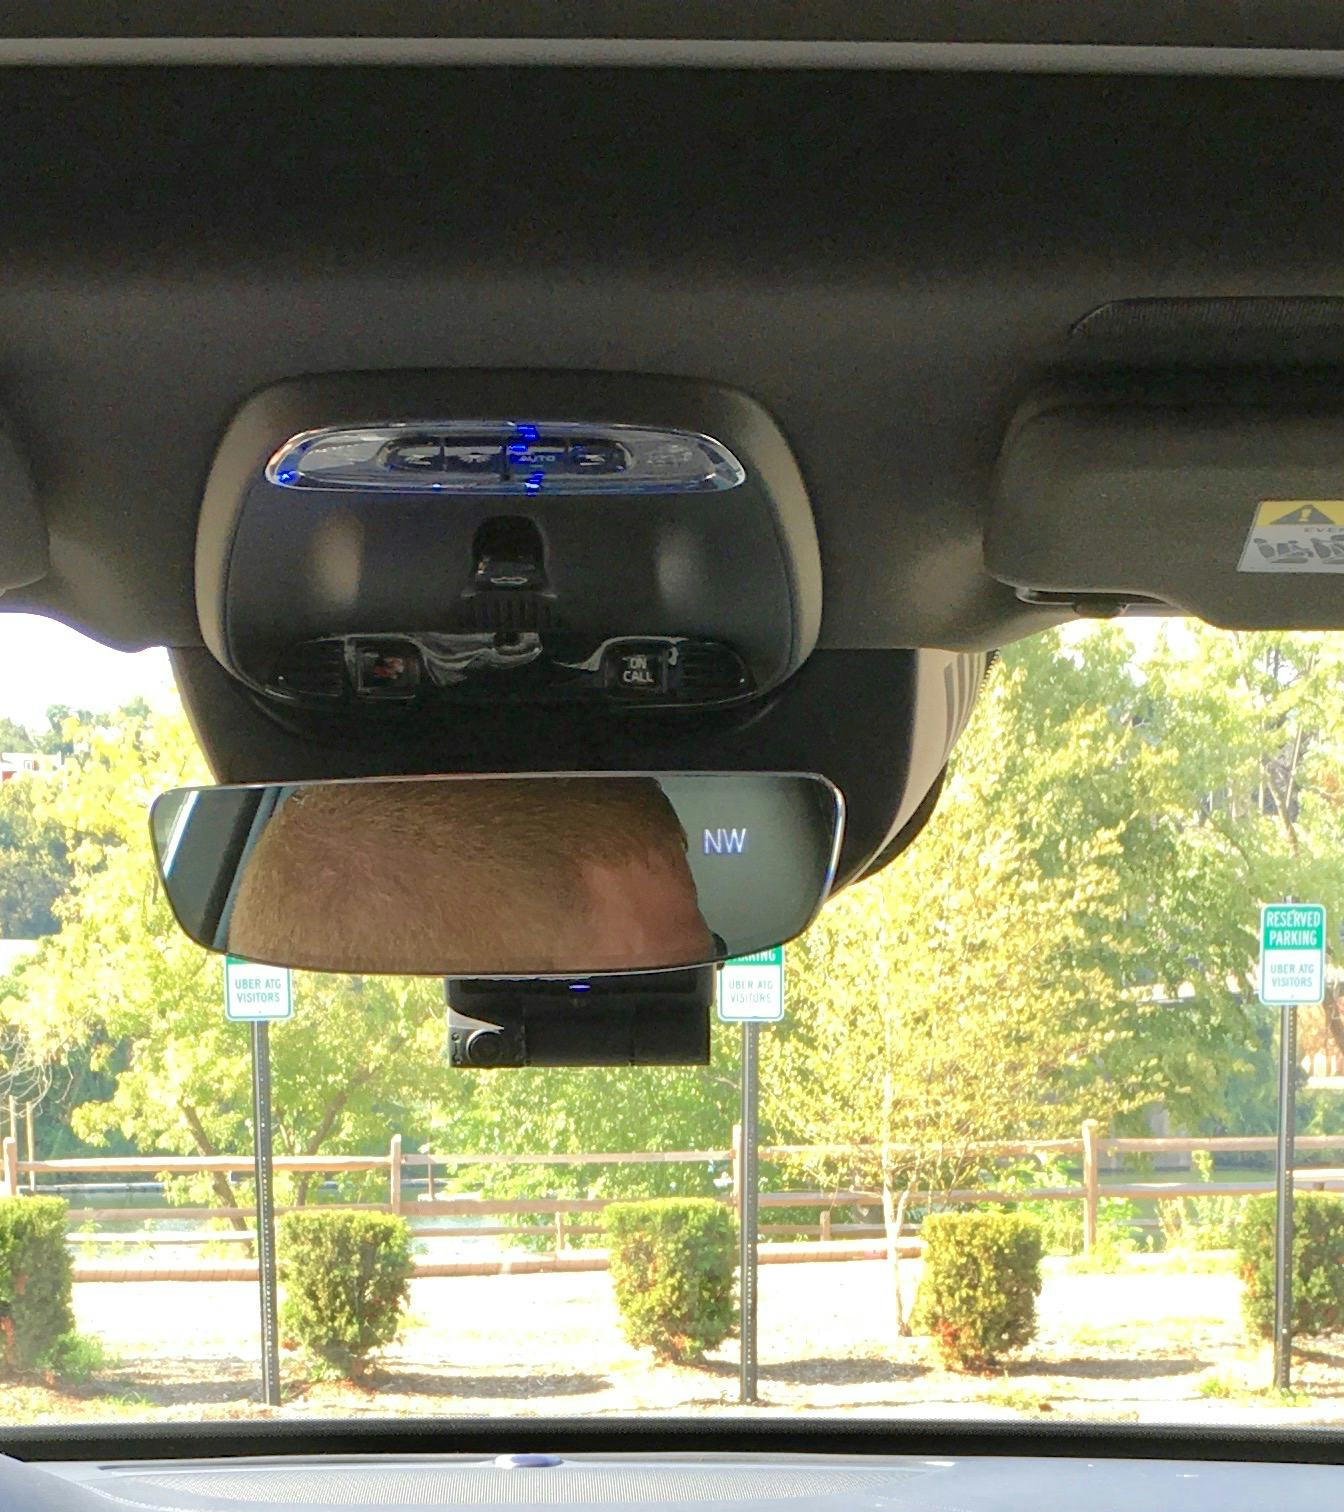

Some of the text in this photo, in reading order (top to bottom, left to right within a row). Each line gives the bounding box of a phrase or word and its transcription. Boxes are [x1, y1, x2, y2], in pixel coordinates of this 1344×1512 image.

[630, 656, 647, 669] ON
[623, 670, 655, 682] CALL
[703, 828, 747, 854] NW
[1266, 911, 1321, 928] RESERVED
[1269, 929, 1317, 946] PARKING
[1270, 963, 1314, 974] UBER ATG
[234, 978, 281, 990] UBER ATG
[1271, 976, 1313, 987] VISITORS
[236, 992, 281, 1003] VISITORS
